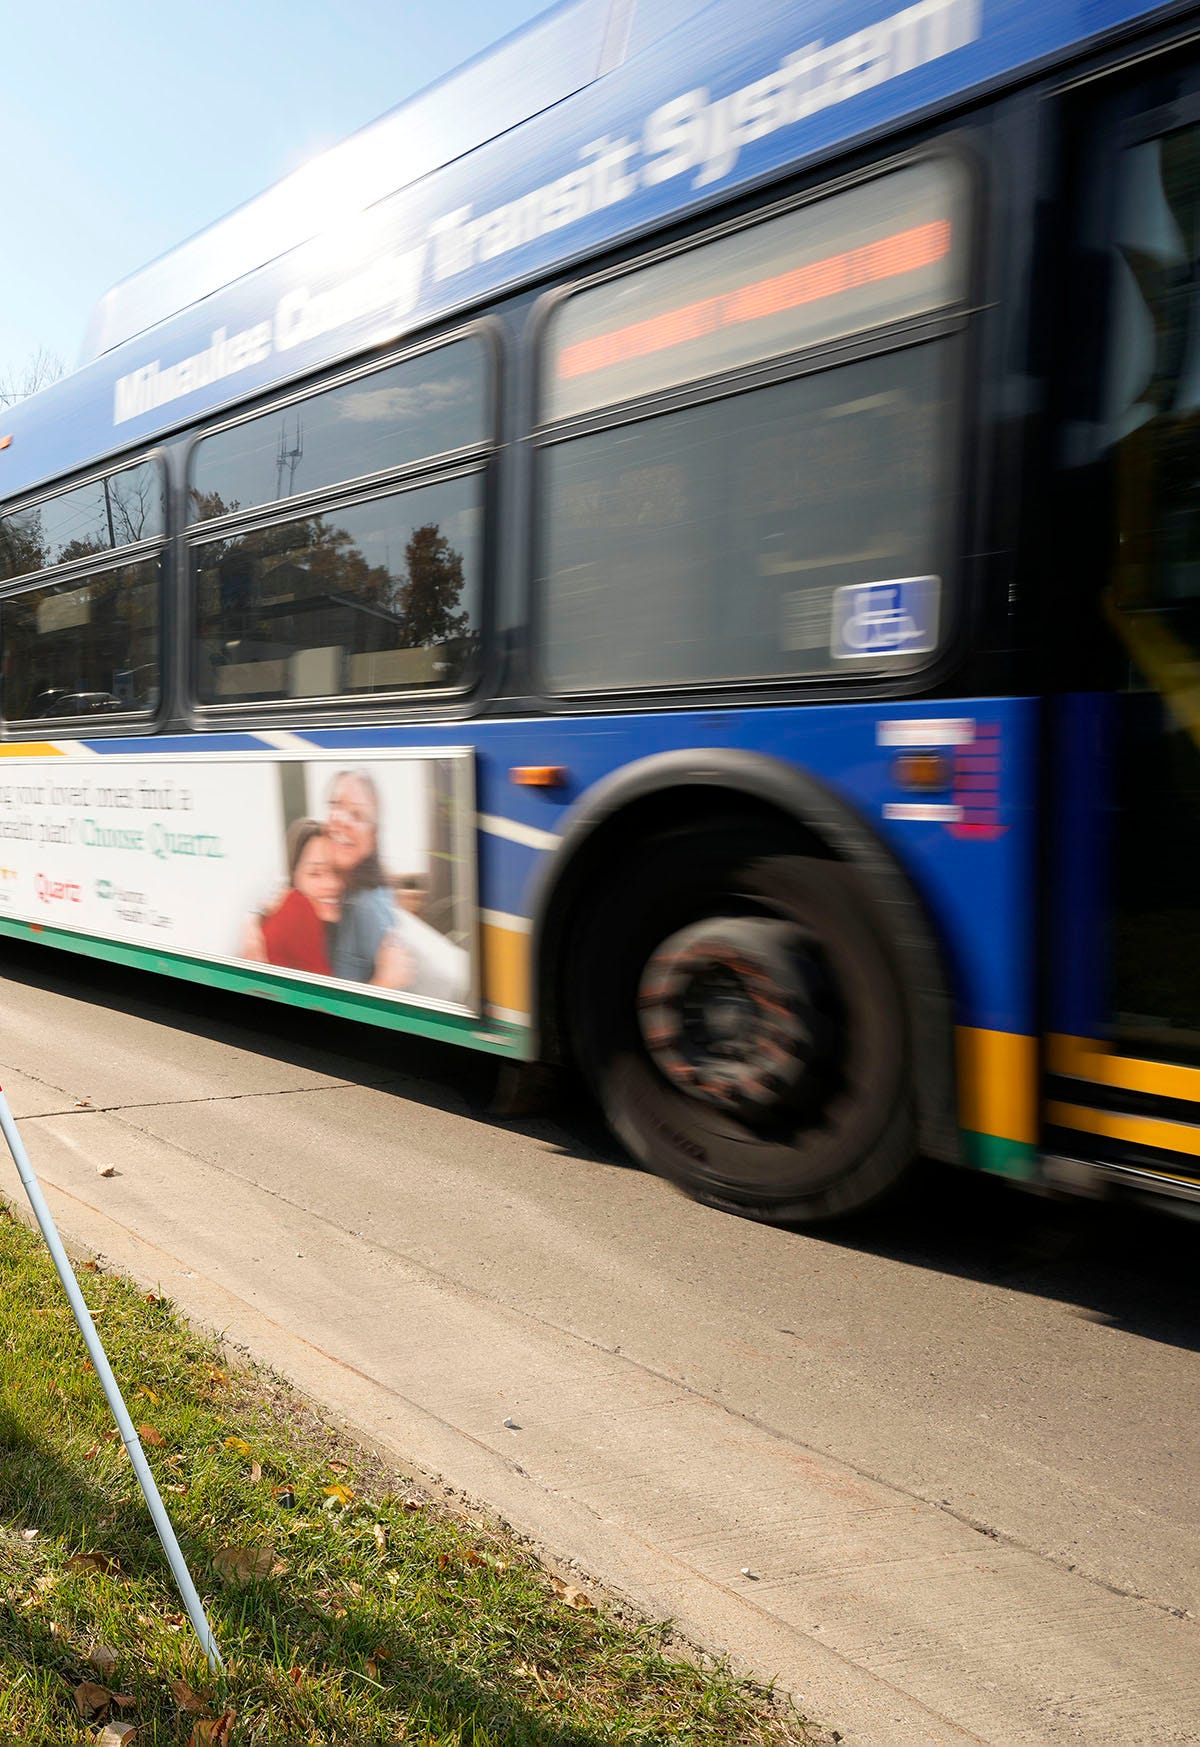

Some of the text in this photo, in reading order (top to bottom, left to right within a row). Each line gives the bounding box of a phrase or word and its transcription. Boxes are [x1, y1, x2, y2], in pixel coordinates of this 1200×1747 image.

[428, 133, 640, 283] Transit
[641, 0, 982, 191] System
[81, 818, 145, 850] Choose
